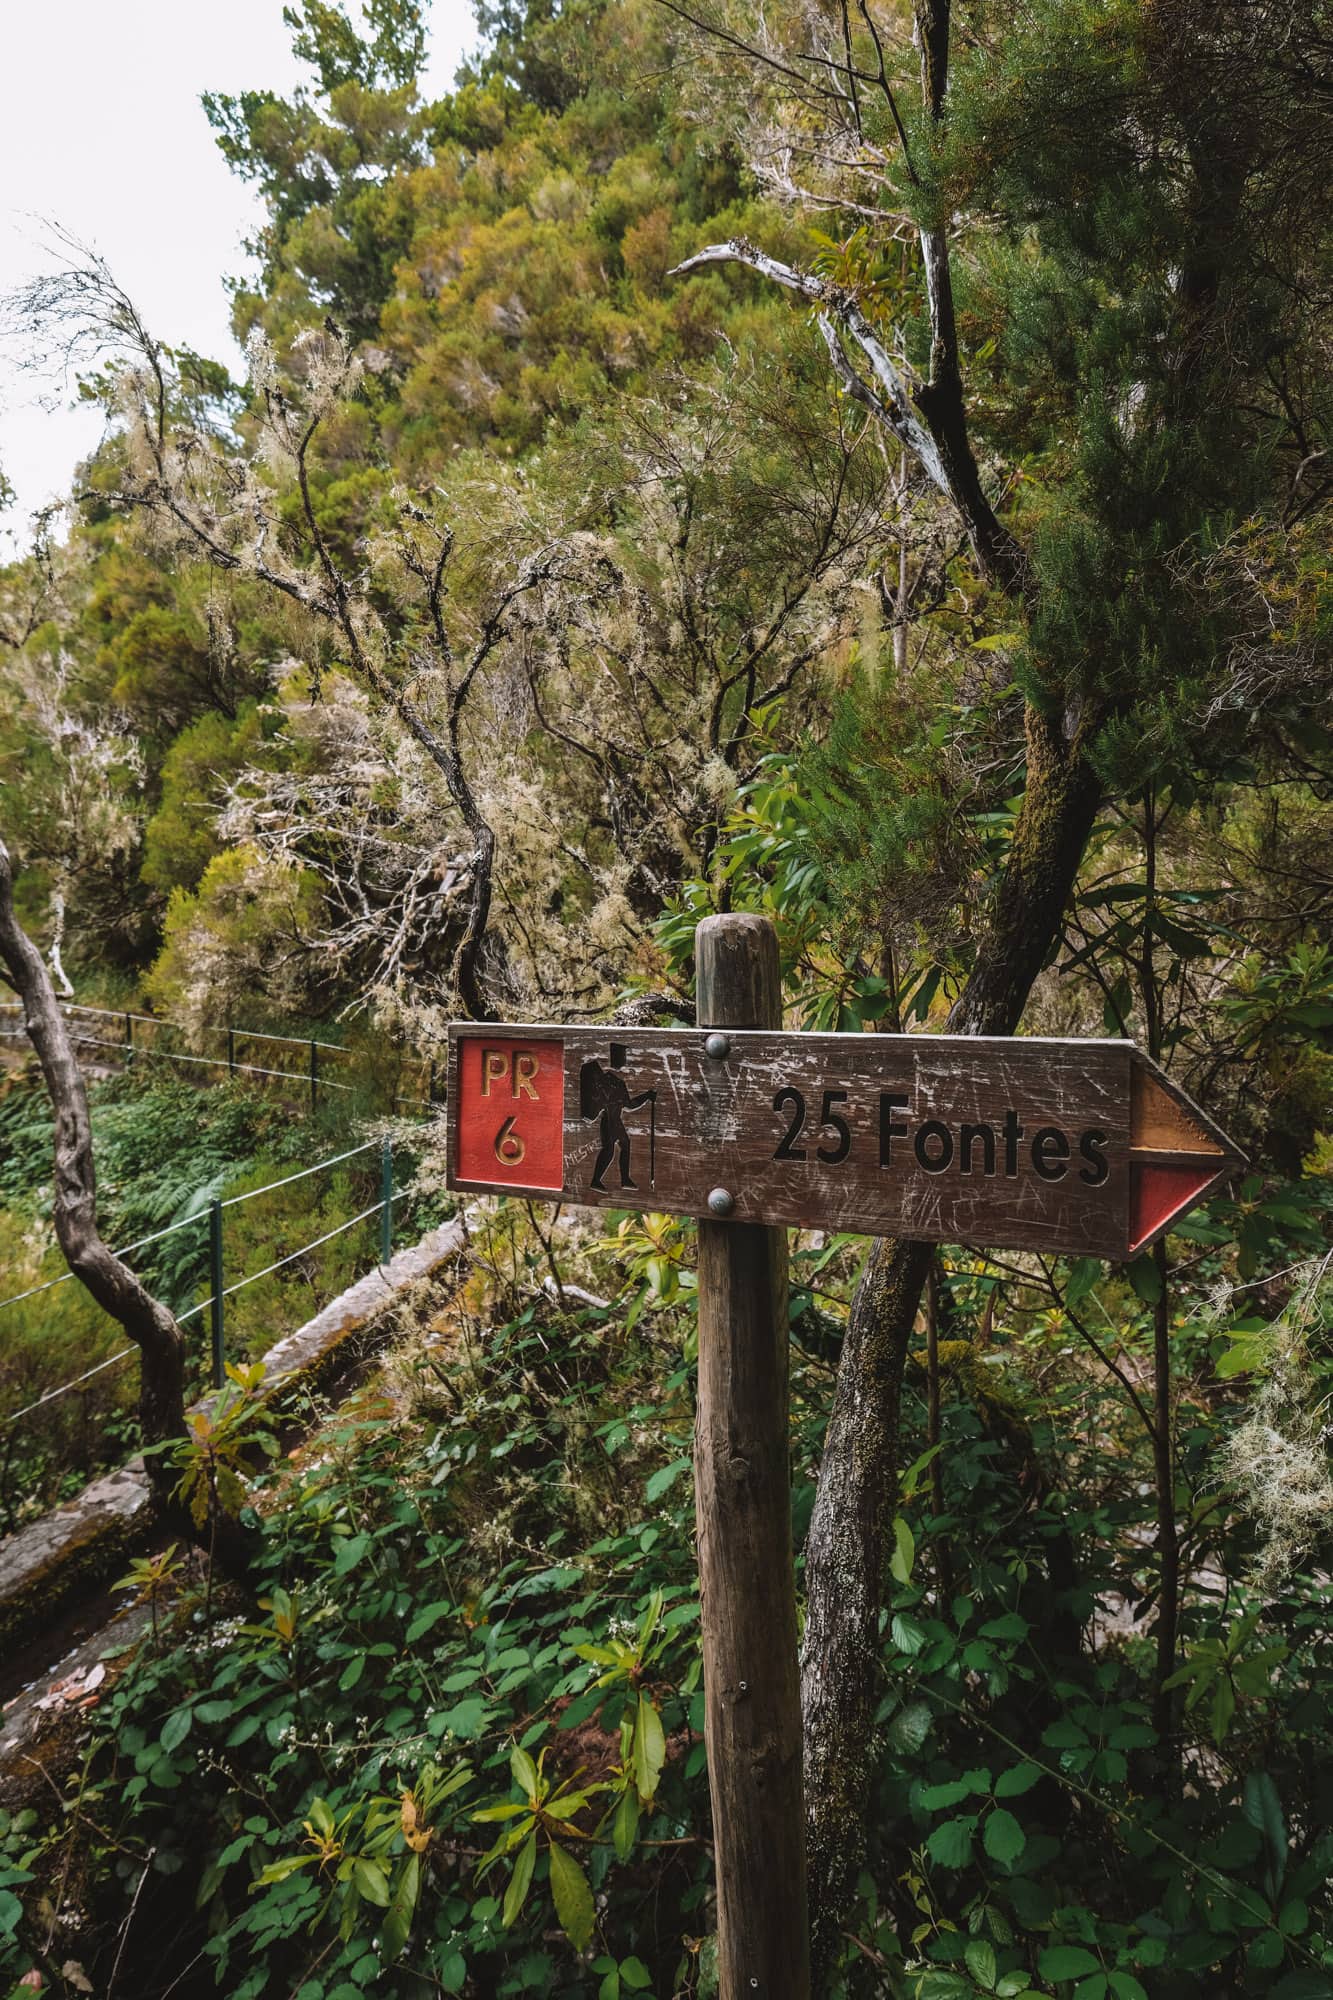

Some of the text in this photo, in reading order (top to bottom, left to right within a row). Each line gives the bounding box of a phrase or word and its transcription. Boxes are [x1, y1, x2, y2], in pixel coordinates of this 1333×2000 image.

[481, 1050, 541, 1100] PR
[494, 1116, 526, 1166] 6
[771, 1086, 1111, 1188] 25 Fontes
